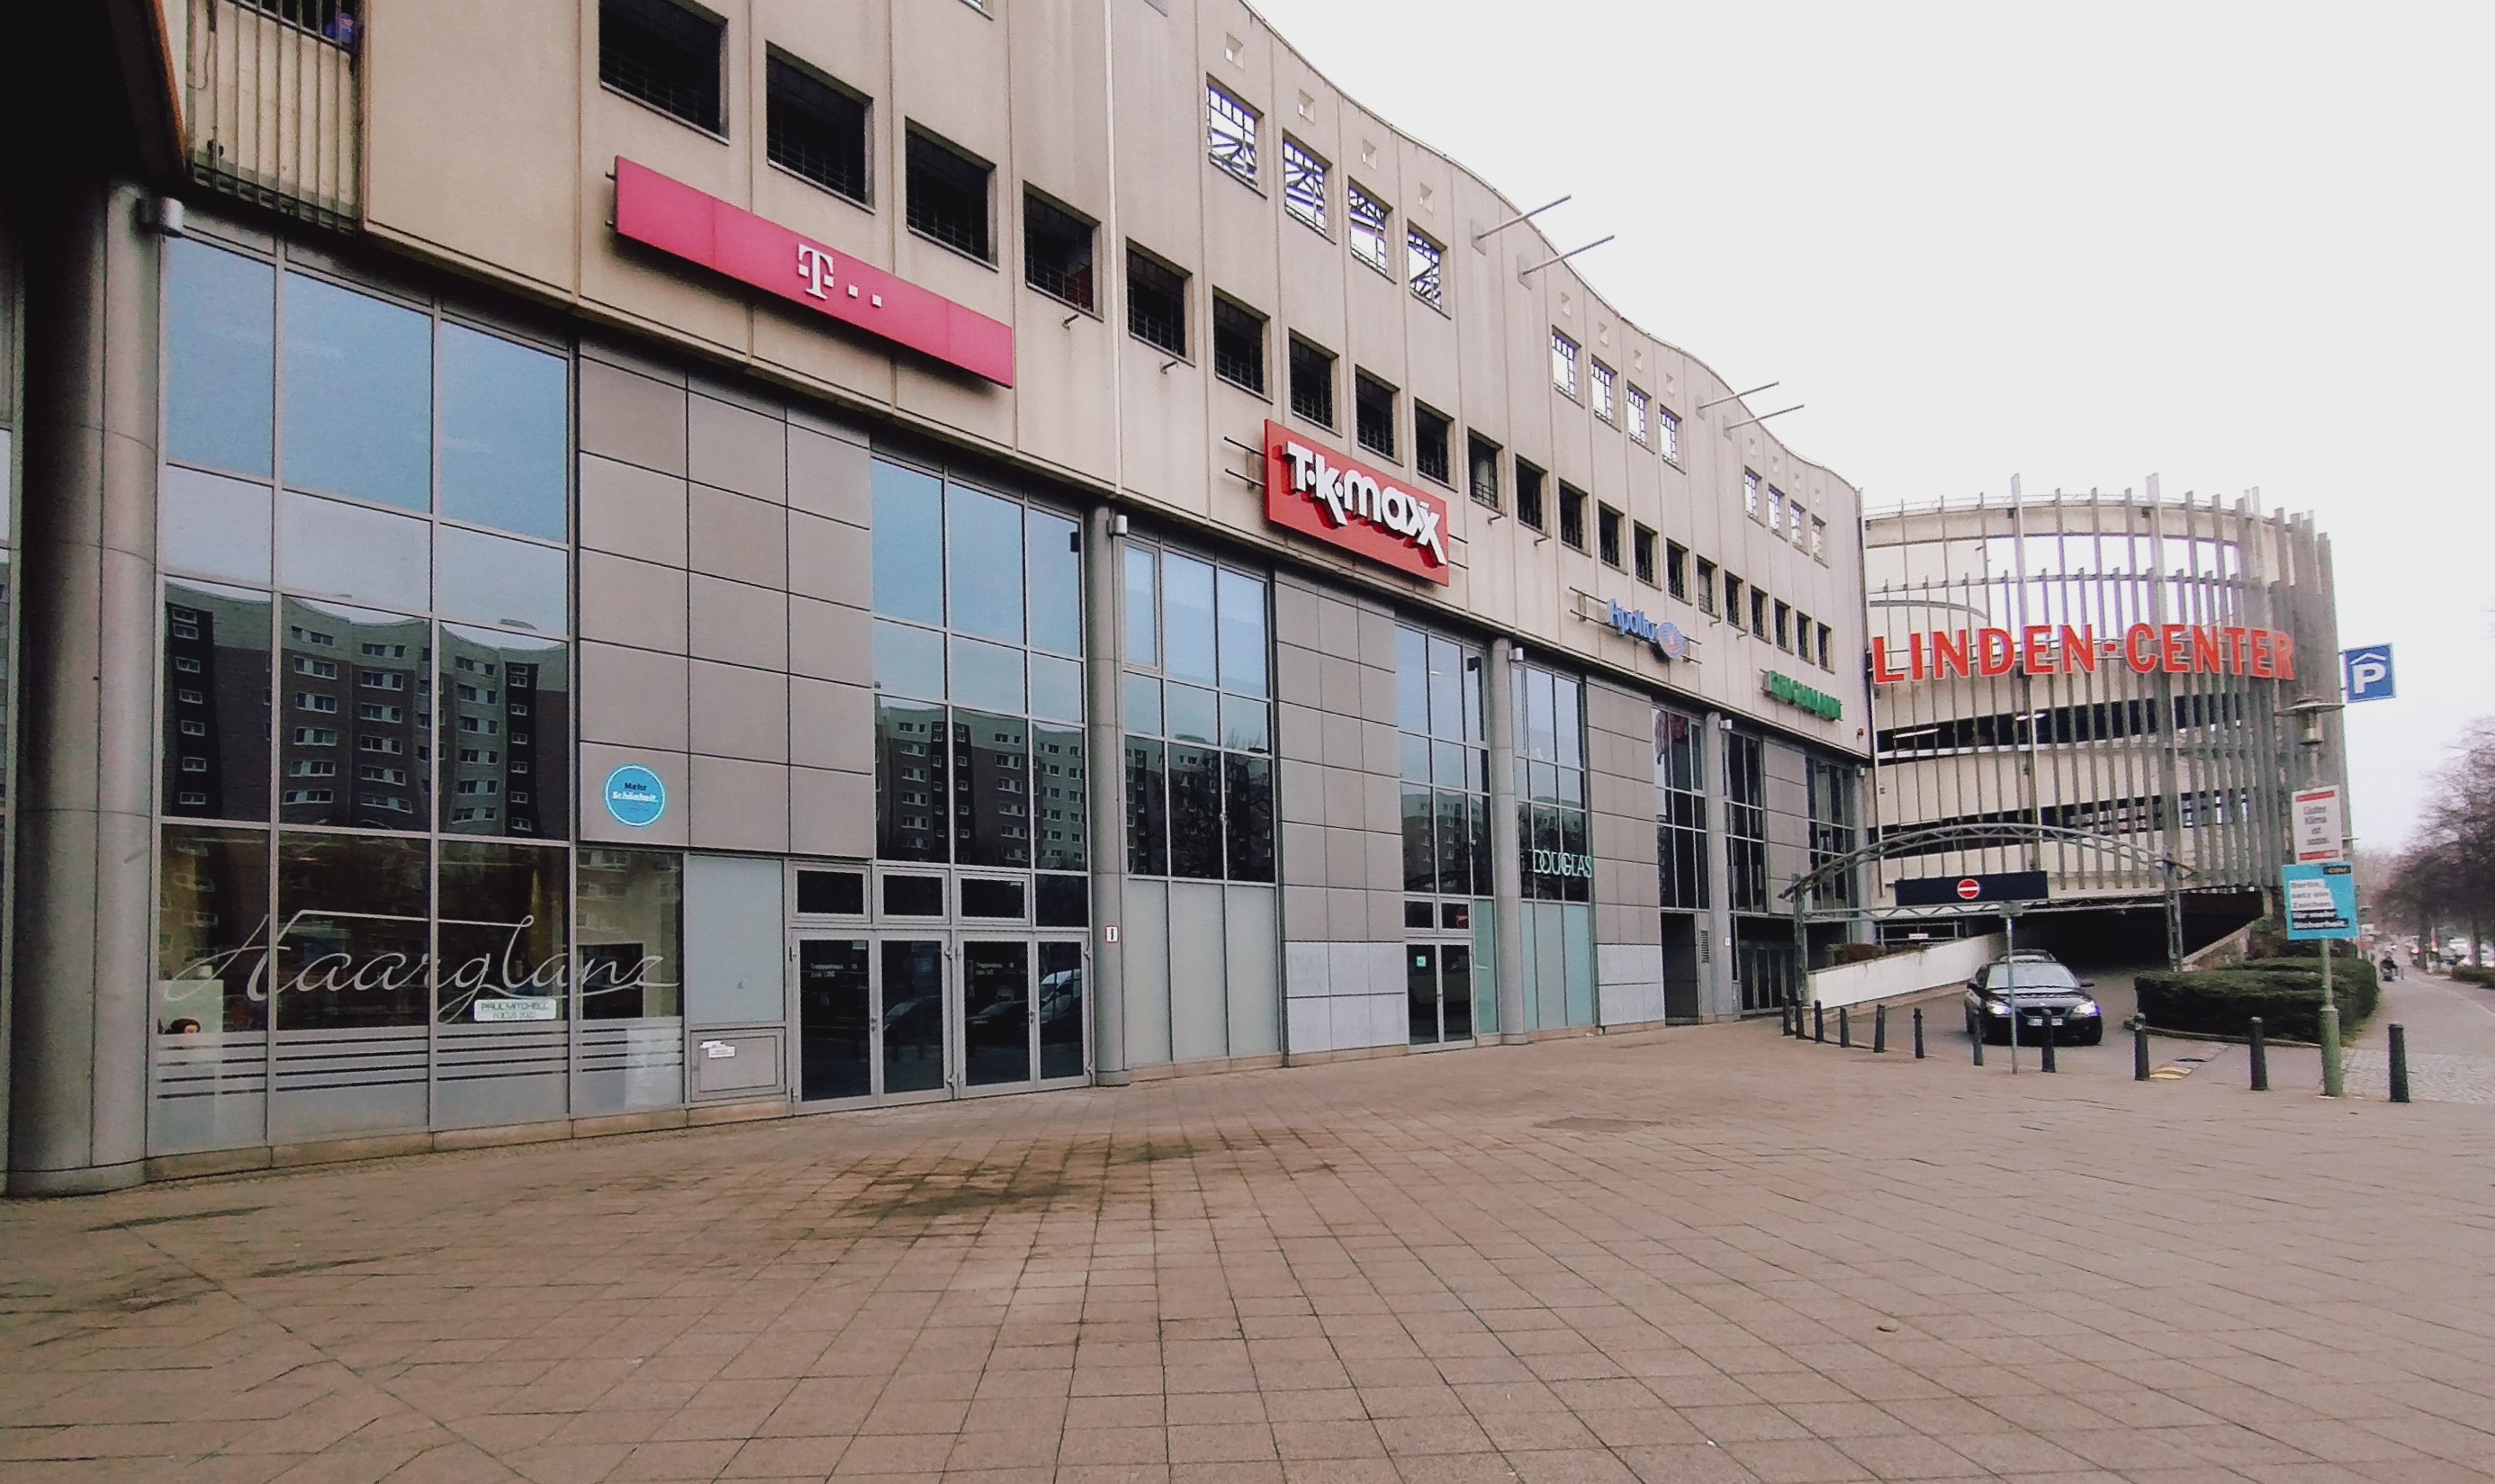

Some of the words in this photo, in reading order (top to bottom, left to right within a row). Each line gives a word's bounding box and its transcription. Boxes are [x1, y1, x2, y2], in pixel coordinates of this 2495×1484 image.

[1871, 622, 2296, 685] LINDEN-CENTER
[2352, 662, 2386, 695] P
[624, 782, 646, 791] Mehr
[1533, 849, 1592, 878] DOUGLAS
[164, 909, 680, 1024] Haarglanz
